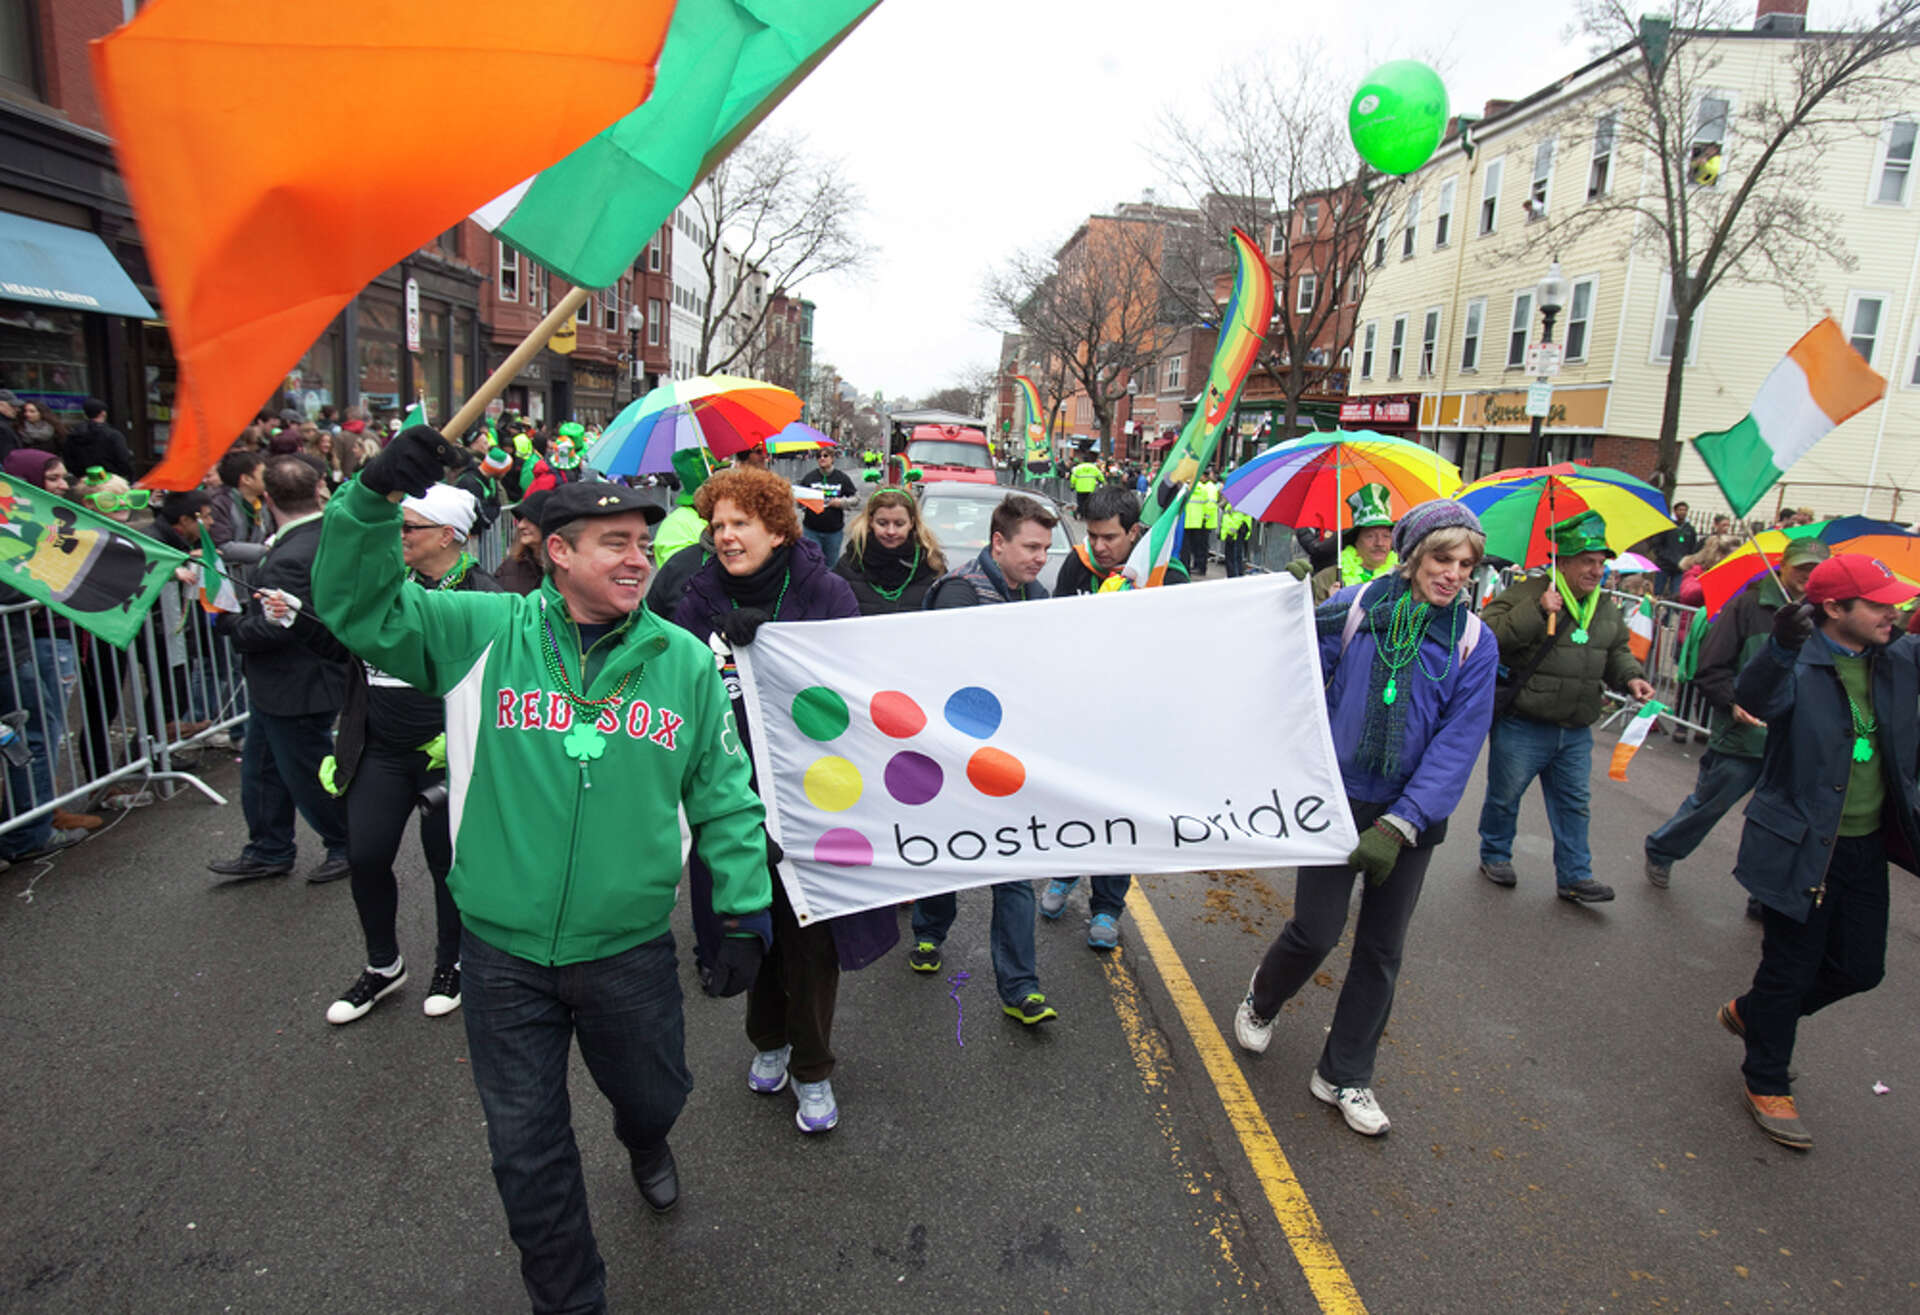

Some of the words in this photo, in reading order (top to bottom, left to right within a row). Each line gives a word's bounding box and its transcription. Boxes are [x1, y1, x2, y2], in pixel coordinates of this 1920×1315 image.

[1, 281, 55, 299] HEALTH
[53, 289, 101, 306] CENTER
[496, 687, 575, 733] RED
[596, 697, 684, 751] SOX
[894, 815, 1137, 867] boston
[1169, 788, 1331, 848] pride
